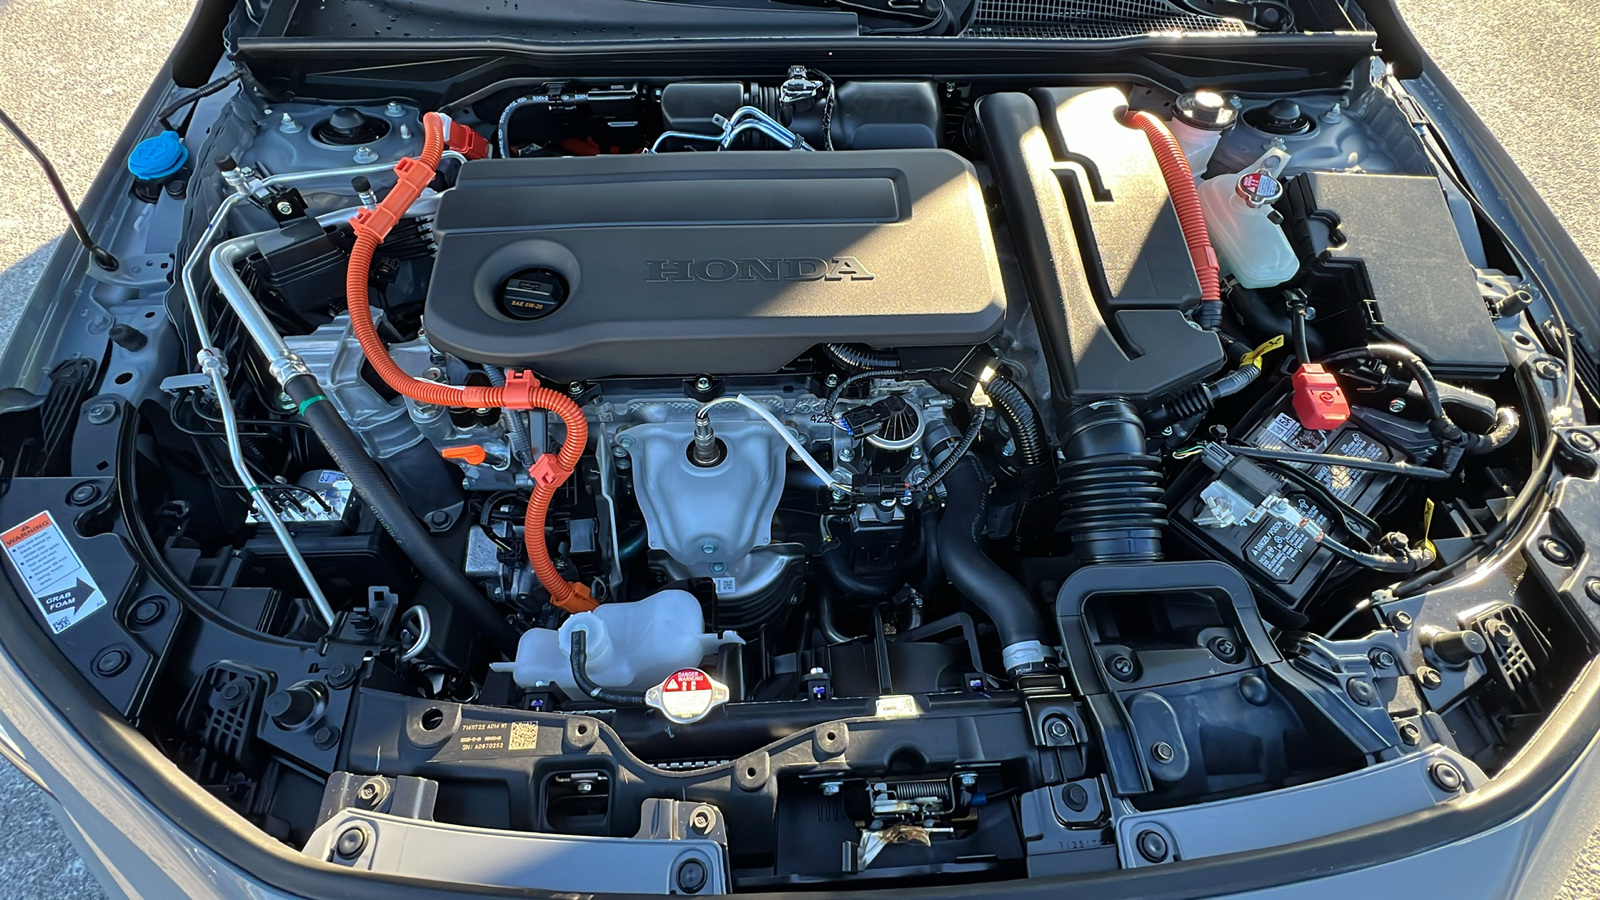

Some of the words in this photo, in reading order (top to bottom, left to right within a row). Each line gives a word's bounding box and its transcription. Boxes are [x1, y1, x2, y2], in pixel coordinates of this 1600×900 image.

[646, 256, 875, 283] HONDA
[6, 521, 49, 545] WARNING
[46, 592, 71, 604] GRAB
[50, 598, 75, 610] FOAM
